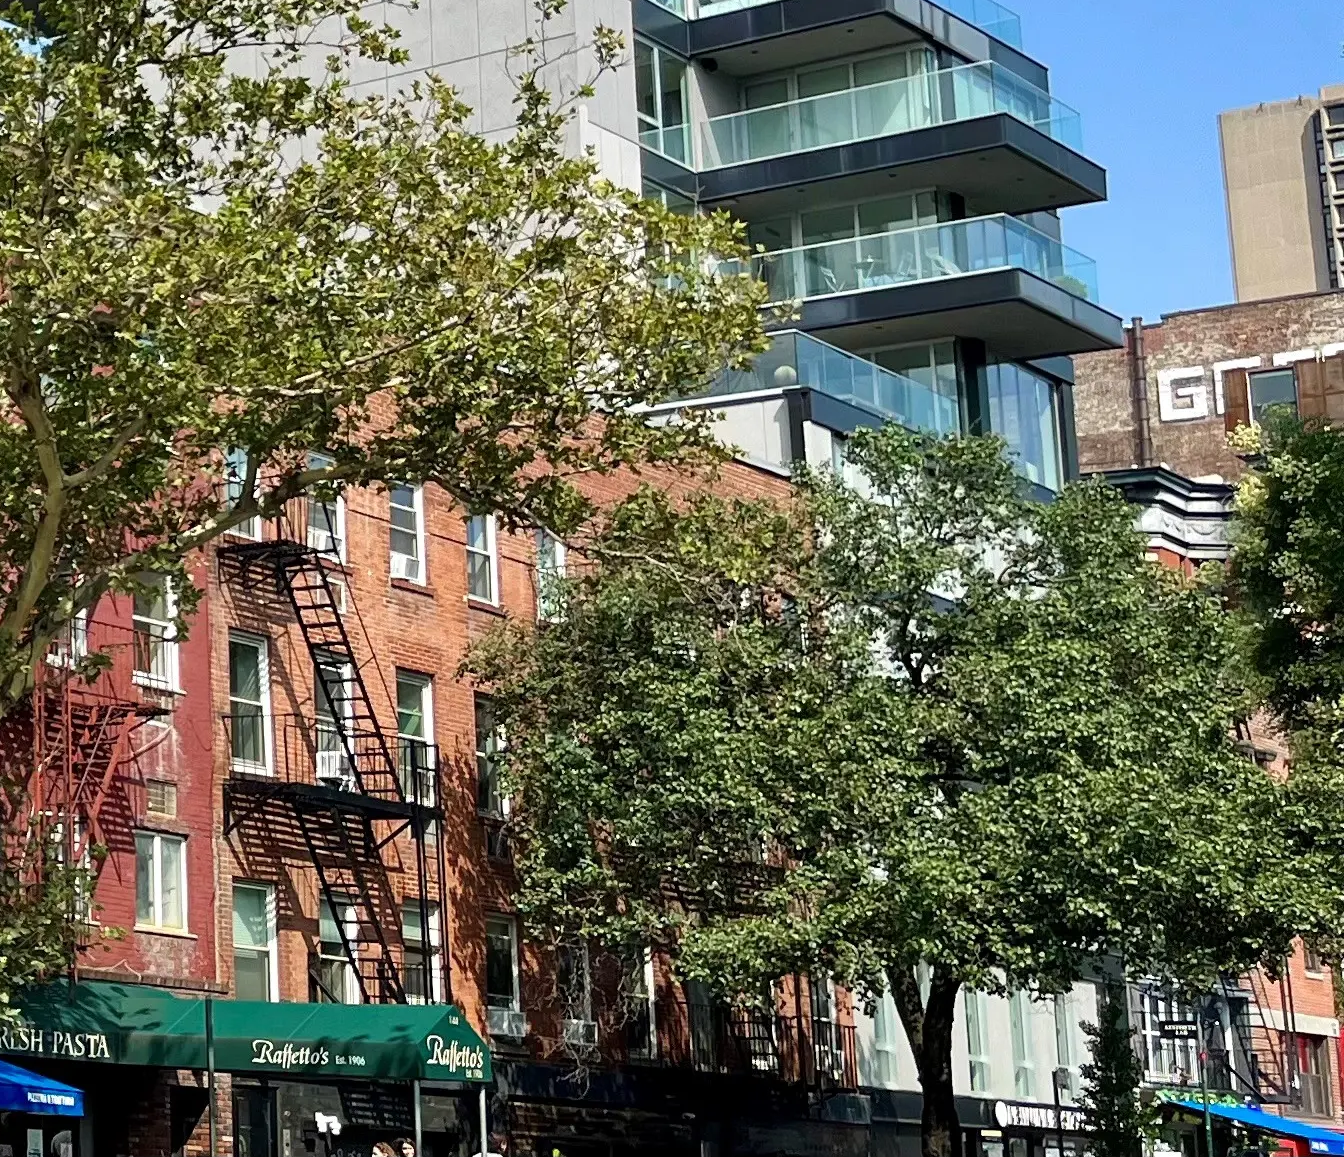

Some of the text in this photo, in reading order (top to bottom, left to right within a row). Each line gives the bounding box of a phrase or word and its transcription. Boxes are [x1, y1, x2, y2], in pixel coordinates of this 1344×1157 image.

[52, 1031, 110, 1058] PASTA
[252, 1039, 329, 1069] Raffetto's
[348, 1055, 366, 1066] 1906
[427, 1035, 484, 1073] Raffetto's
